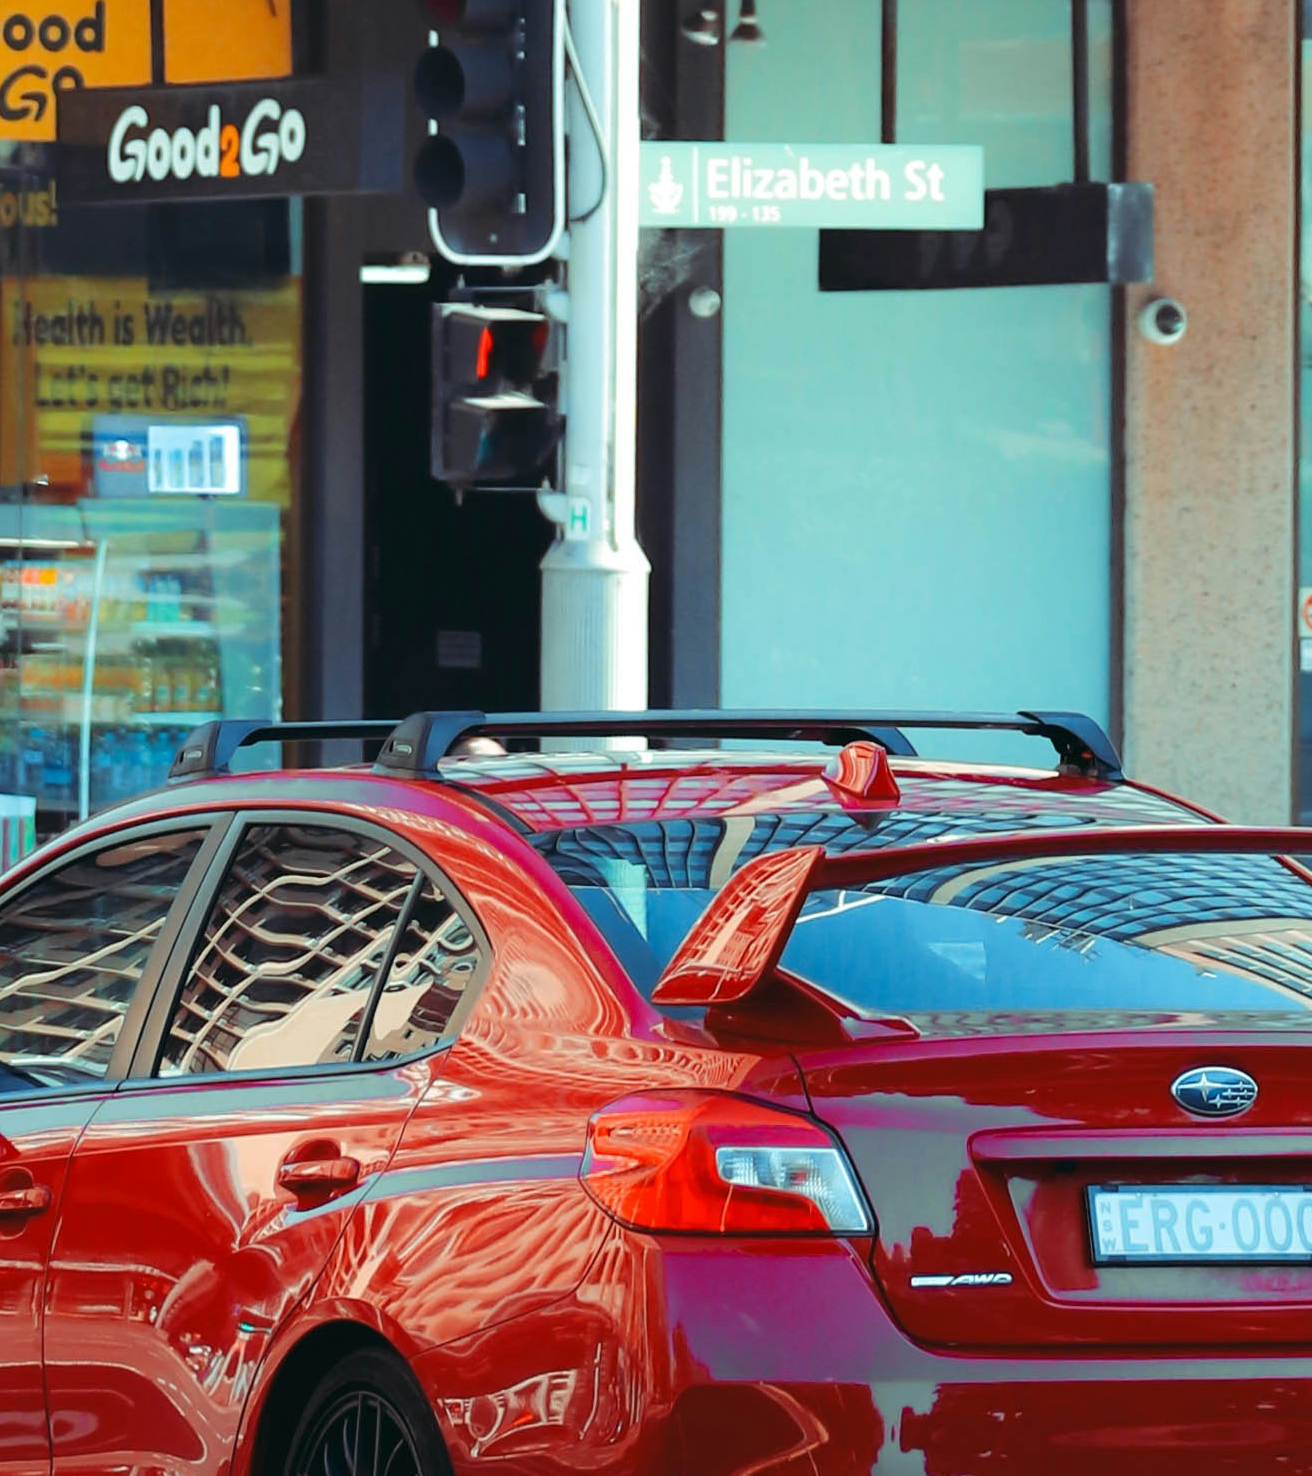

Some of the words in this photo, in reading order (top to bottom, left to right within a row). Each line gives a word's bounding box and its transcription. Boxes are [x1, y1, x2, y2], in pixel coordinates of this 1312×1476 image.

[107, 98, 306, 183] Good2Go
[706, 157, 891, 200] Elizabeth
[903, 160, 945, 201] St
[708, 205, 737, 223] 199
[751, 205, 781, 223] 135
[113, 300, 135, 346] is
[949, 1272, 1013, 1286] AWD
